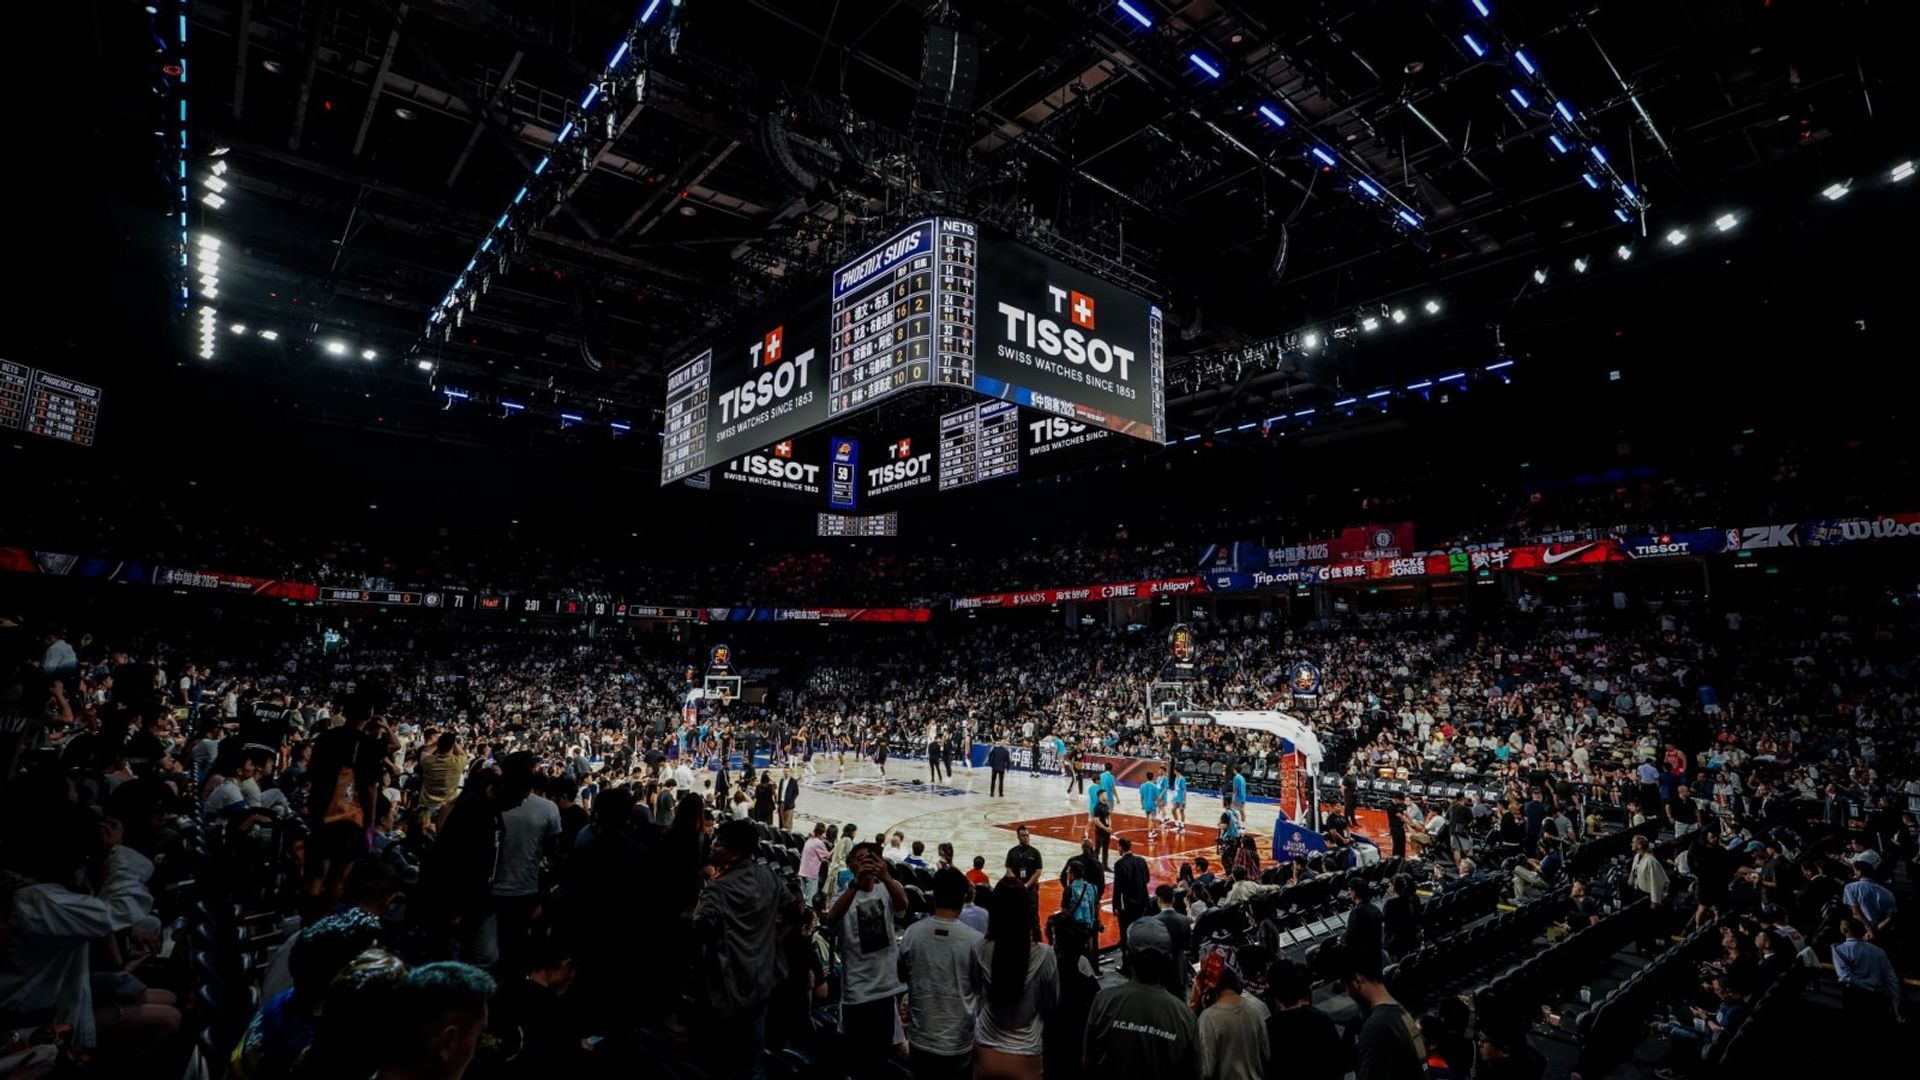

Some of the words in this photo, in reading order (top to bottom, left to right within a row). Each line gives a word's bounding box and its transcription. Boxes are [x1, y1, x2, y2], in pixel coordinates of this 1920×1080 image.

[943, 221, 974, 236] NETS
[946, 236, 954, 246] 12
[840, 252, 882, 291] PHOENIX
[884, 230, 921, 267] SUNS
[946, 265, 954, 275] 14
[898, 285, 905, 296] 6
[916, 276, 923, 289] 1
[945, 294, 953, 305] 24
[896, 304, 907, 319] 16
[914, 298, 923, 311] 2
[897, 328, 904, 340] 8
[914, 321, 921, 333] 1
[945, 325, 953, 335] 33
[998, 301, 1135, 381] TISSOT
[896, 350, 903, 362] 2
[914, 343, 921, 356] 1
[894, 371, 905, 384] 10
[913, 367, 922, 379] 0
[998, 345, 1033, 366] SWISS
[1034, 356, 1083, 382] WATCHES
[1085, 374, 1114, 393] SINCE
[1115, 384, 1136, 400] 1853
[718, 348, 815, 424] TISSOT
[716, 425, 736, 442] SWISS
[737, 411, 769, 433] WATCHES
[770, 399, 793, 419] SINCE
[795, 391, 813, 408] 1853
[1029, 444, 1050, 456] SWISS
[1051, 435, 1085, 451] WATCHES
[1086, 430, 1108, 443] SINCE
[837, 466, 848, 480] 59
[868, 453, 931, 487] TISSOT
[724, 471, 747, 482] SWISS
[748, 476, 781, 487] WATCHES
[782, 481, 803, 491] SINCE
[804, 485, 819, 493] 1853
[1741, 523, 1798, 550] 2K
[1275, 543, 1328, 563] 中国赛2025
[1635, 542, 1689, 555] TISSOT
[173, 570, 219, 589] 中国赛2025
[1252, 571, 1299, 586] Trip.com
[1330, 565, 1366, 579] 佳得乐
[1389, 566, 1425, 576] JONES
[403, 593, 411, 603] 0
[454, 595, 464, 608] 71
[1019, 592, 1046, 604] SANDS
[594, 603, 605, 615] 59
[1148, 1026, 1178, 1041] Bristol
